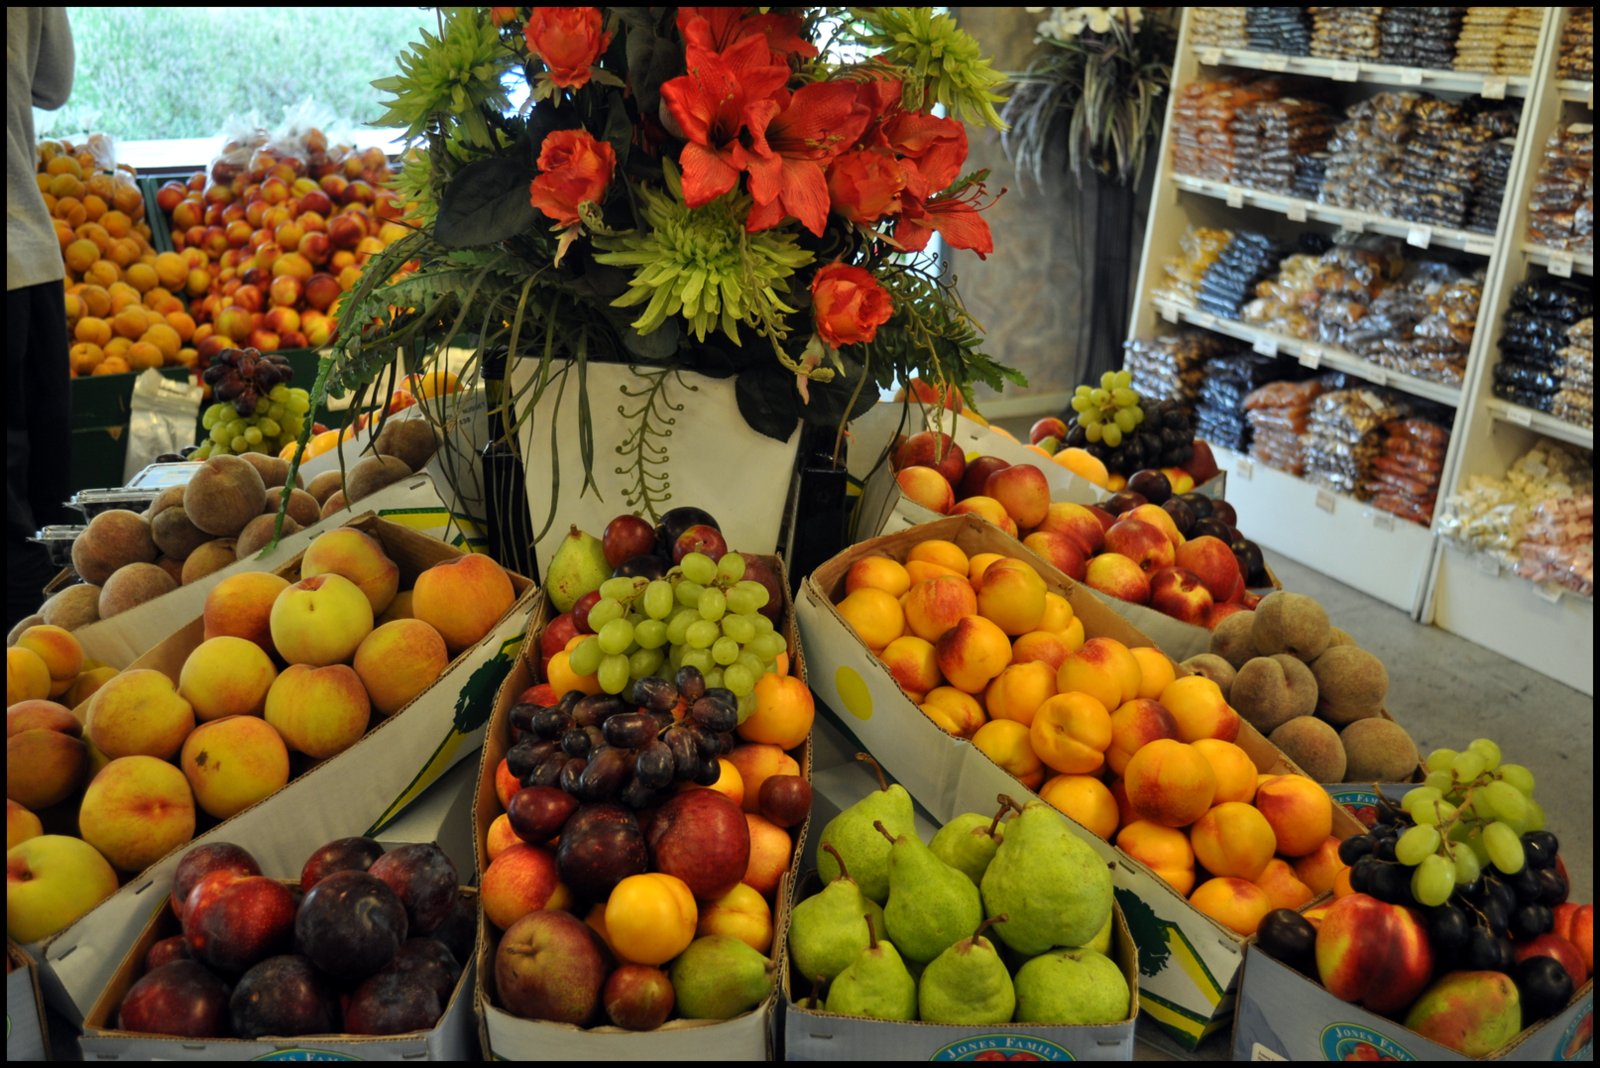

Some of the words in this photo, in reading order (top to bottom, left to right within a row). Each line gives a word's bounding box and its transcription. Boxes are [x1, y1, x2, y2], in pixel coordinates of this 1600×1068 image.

[1336, 1027, 1373, 1042] JONES
[947, 1039, 996, 1058] JONES
[1006, 1037, 1060, 1059] FAMILY
